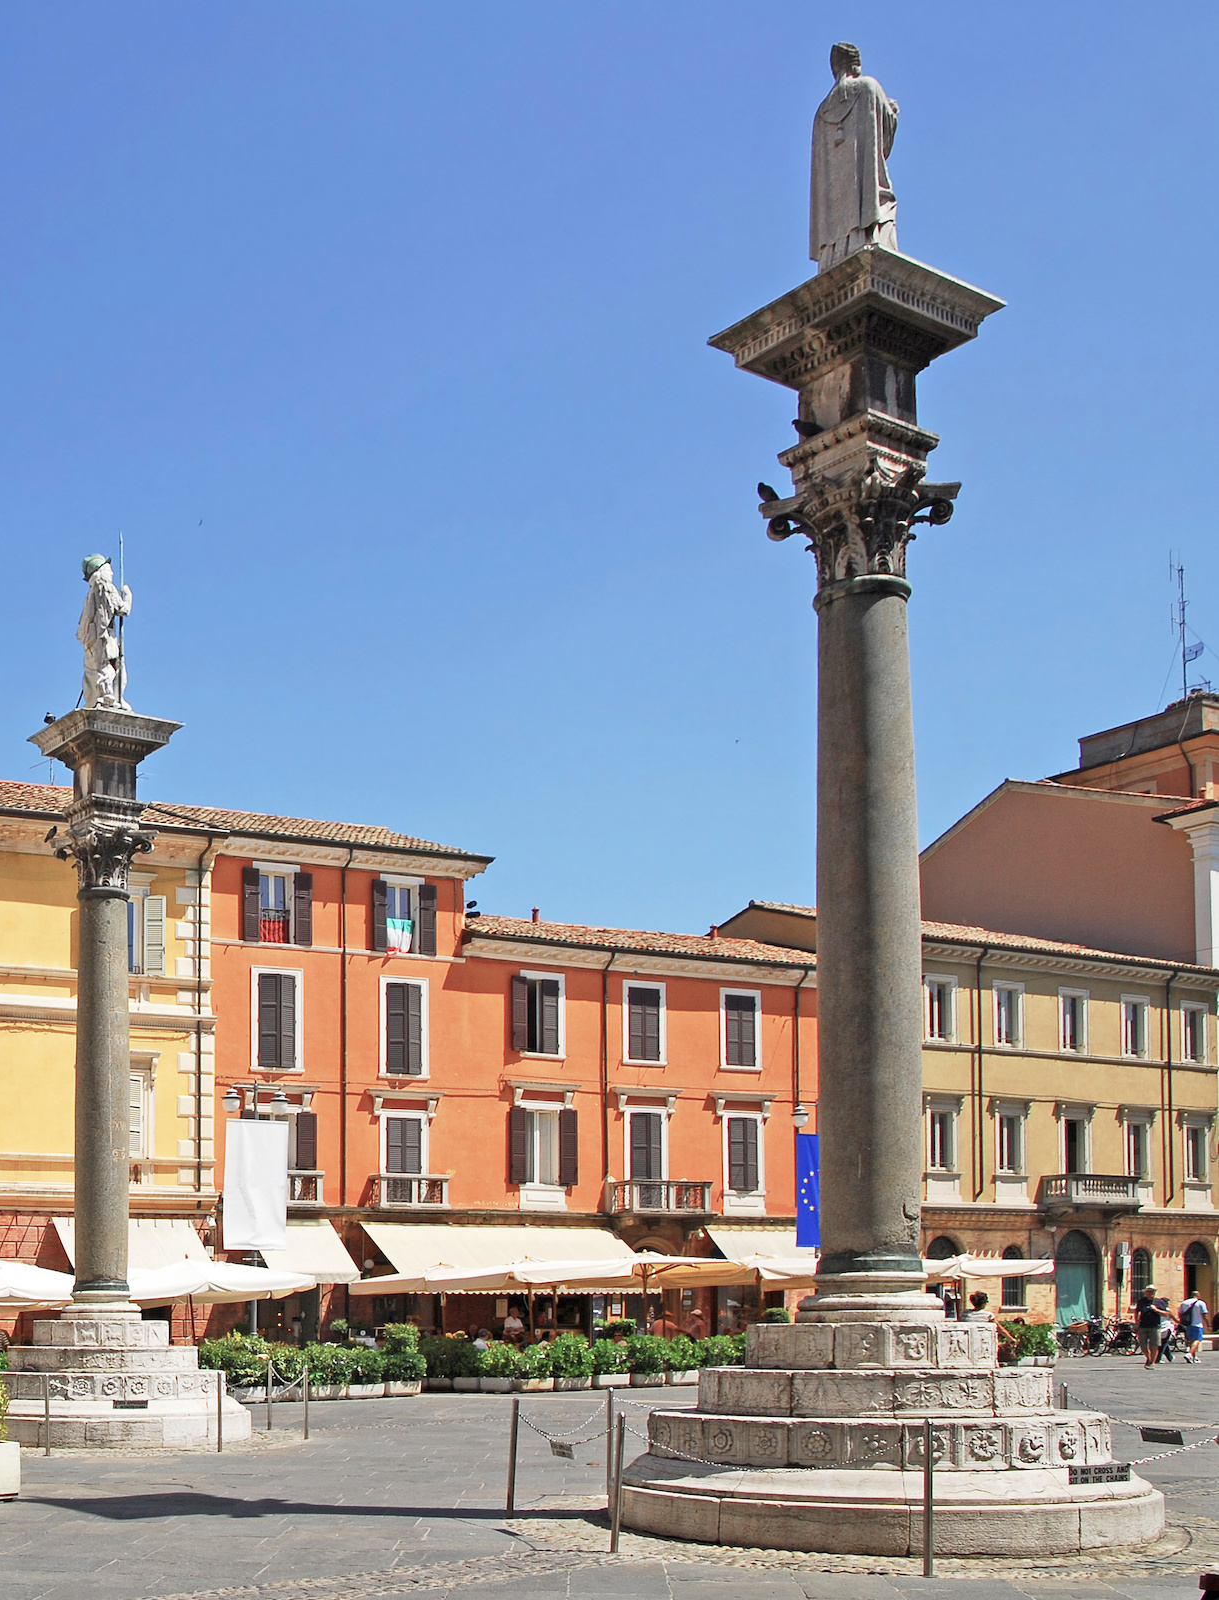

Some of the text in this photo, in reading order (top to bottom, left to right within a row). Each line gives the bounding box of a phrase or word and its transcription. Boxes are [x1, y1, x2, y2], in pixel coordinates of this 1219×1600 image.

[1069, 1468, 1078, 1476] DO
[1094, 1467, 1113, 1475] CROSS
[1081, 1476, 1089, 1484] ON
